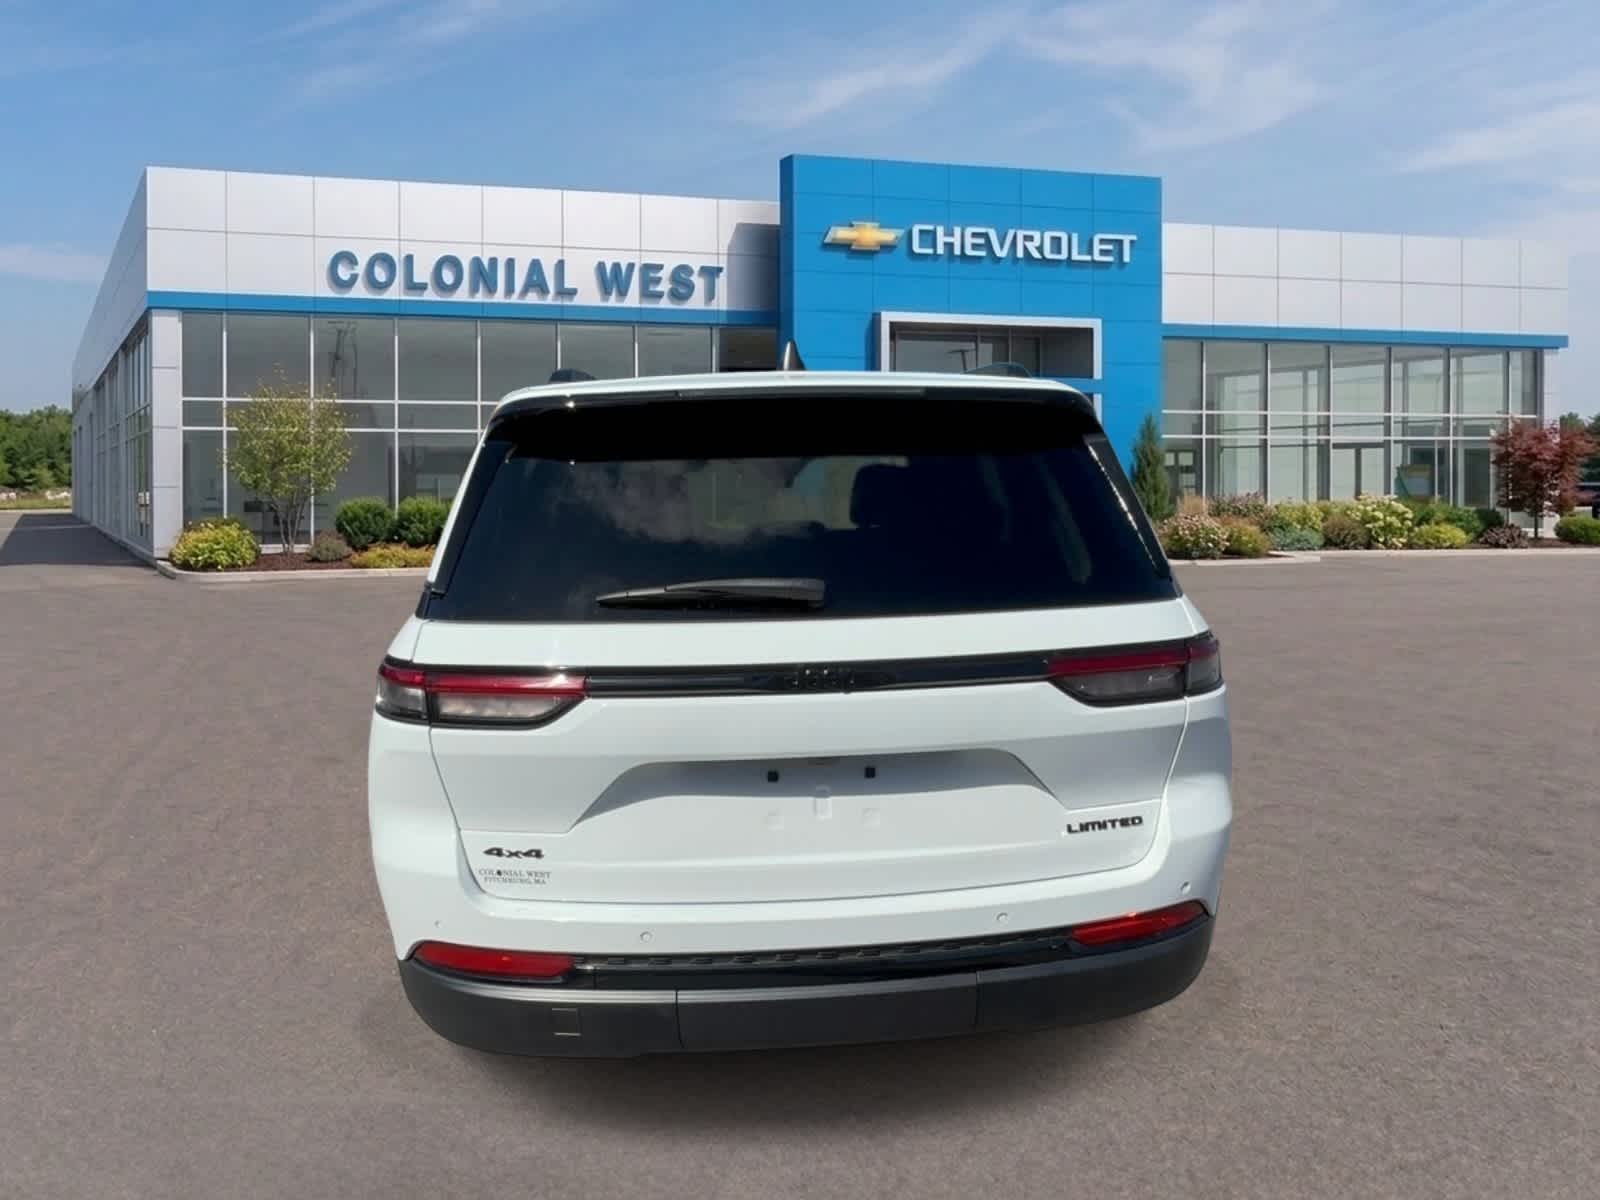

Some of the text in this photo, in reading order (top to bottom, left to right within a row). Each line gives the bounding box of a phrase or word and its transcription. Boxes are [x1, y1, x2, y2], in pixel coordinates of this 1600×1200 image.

[910, 223, 1138, 263] CHEVROLET
[328, 250, 724, 302] COLONIAL WEST
[1066, 815, 1143, 834] LIMITED
[479, 868, 552, 880] COLONIAL WEST
